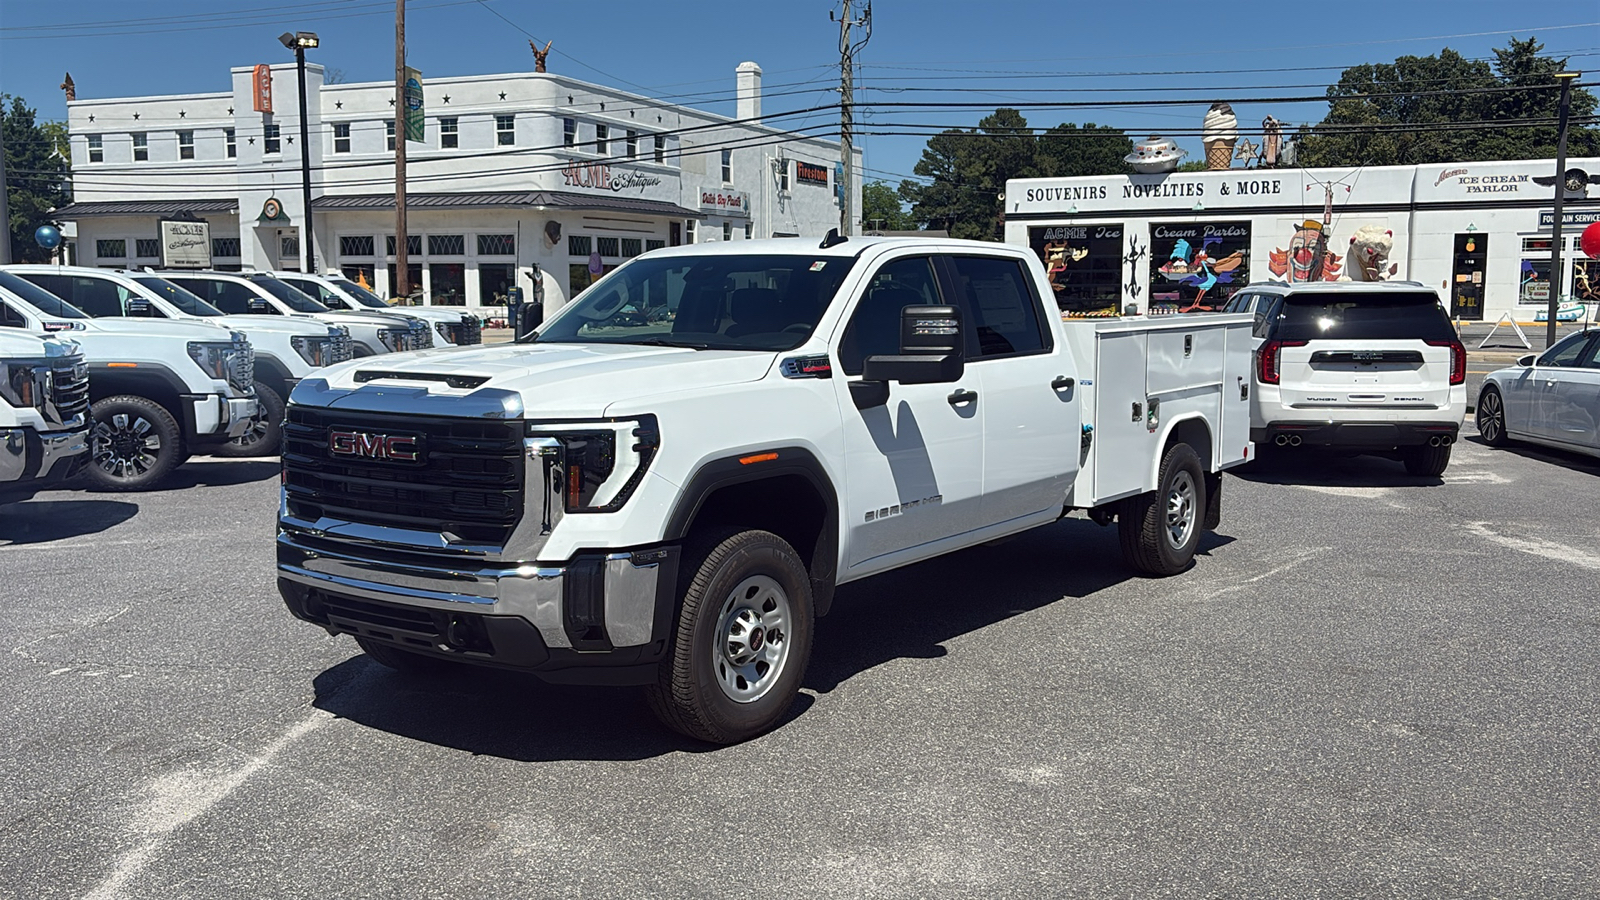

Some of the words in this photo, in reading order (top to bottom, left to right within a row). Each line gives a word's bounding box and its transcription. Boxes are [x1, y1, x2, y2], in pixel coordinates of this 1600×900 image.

[261, 68, 270, 109] ACME
[561, 158, 611, 190] ACME
[797, 161, 827, 182] Firestone
[1458, 176, 1479, 184] ICE
[1482, 174, 1529, 184] CREAM
[1026, 185, 1107, 202] SOUVENIRS
[1122, 182, 1204, 199] NOVELTIES
[1219, 181, 1231, 196] &
[1236, 180, 1281, 195] MORE
[1466, 184, 1519, 193] PARLOR
[702, 192, 716, 205] Dutch
[717, 193, 727, 208] Boy
[726, 194, 742, 207] Paints
[1043, 227, 1088, 240] ACME
[1094, 226, 1122, 239] Ice
[1154, 225, 1198, 239] Cream
[1203, 224, 1249, 238] Parlor
[330, 431, 417, 461] GMC
